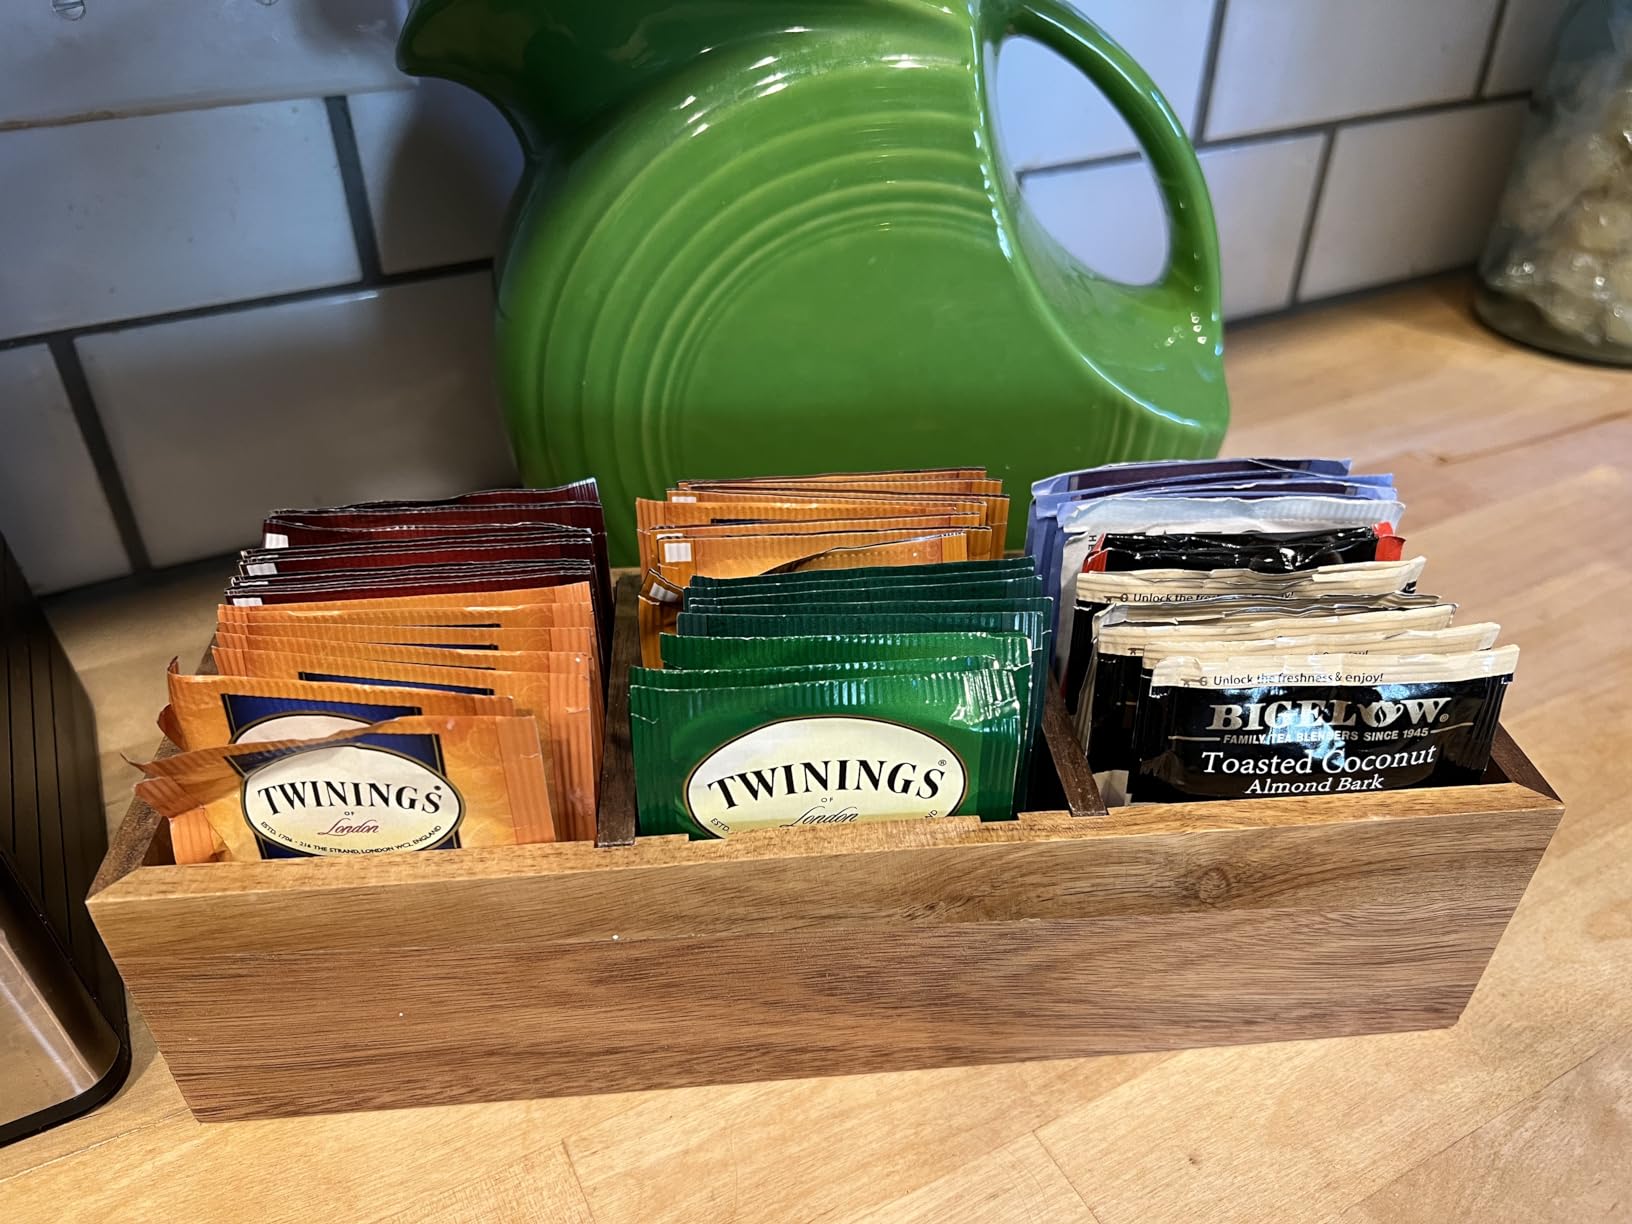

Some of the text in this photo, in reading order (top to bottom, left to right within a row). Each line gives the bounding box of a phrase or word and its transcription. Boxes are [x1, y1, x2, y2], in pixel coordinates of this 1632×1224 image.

[1133, 593, 1172, 602] Unlock
[1213, 672, 1384, 686] Unlock the freshness & enjoy!
[1205, 697, 1452, 731] BIGELOW
[1223, 734, 1265, 745] FAMILY
[1269, 733, 1292, 744] TEA
[1363, 730, 1399, 742] SINCE
[1402, 727, 1429, 739] 1945
[1201, 745, 1436, 774] Toasted Coconut
[706, 759, 946, 810] TWININGS
[1244, 774, 1385, 795] Almond Bark
[257, 780, 442, 816] TWININGS
[317, 817, 380, 837] London
[779, 805, 858, 828] London
[313, 844, 328, 852] THE
